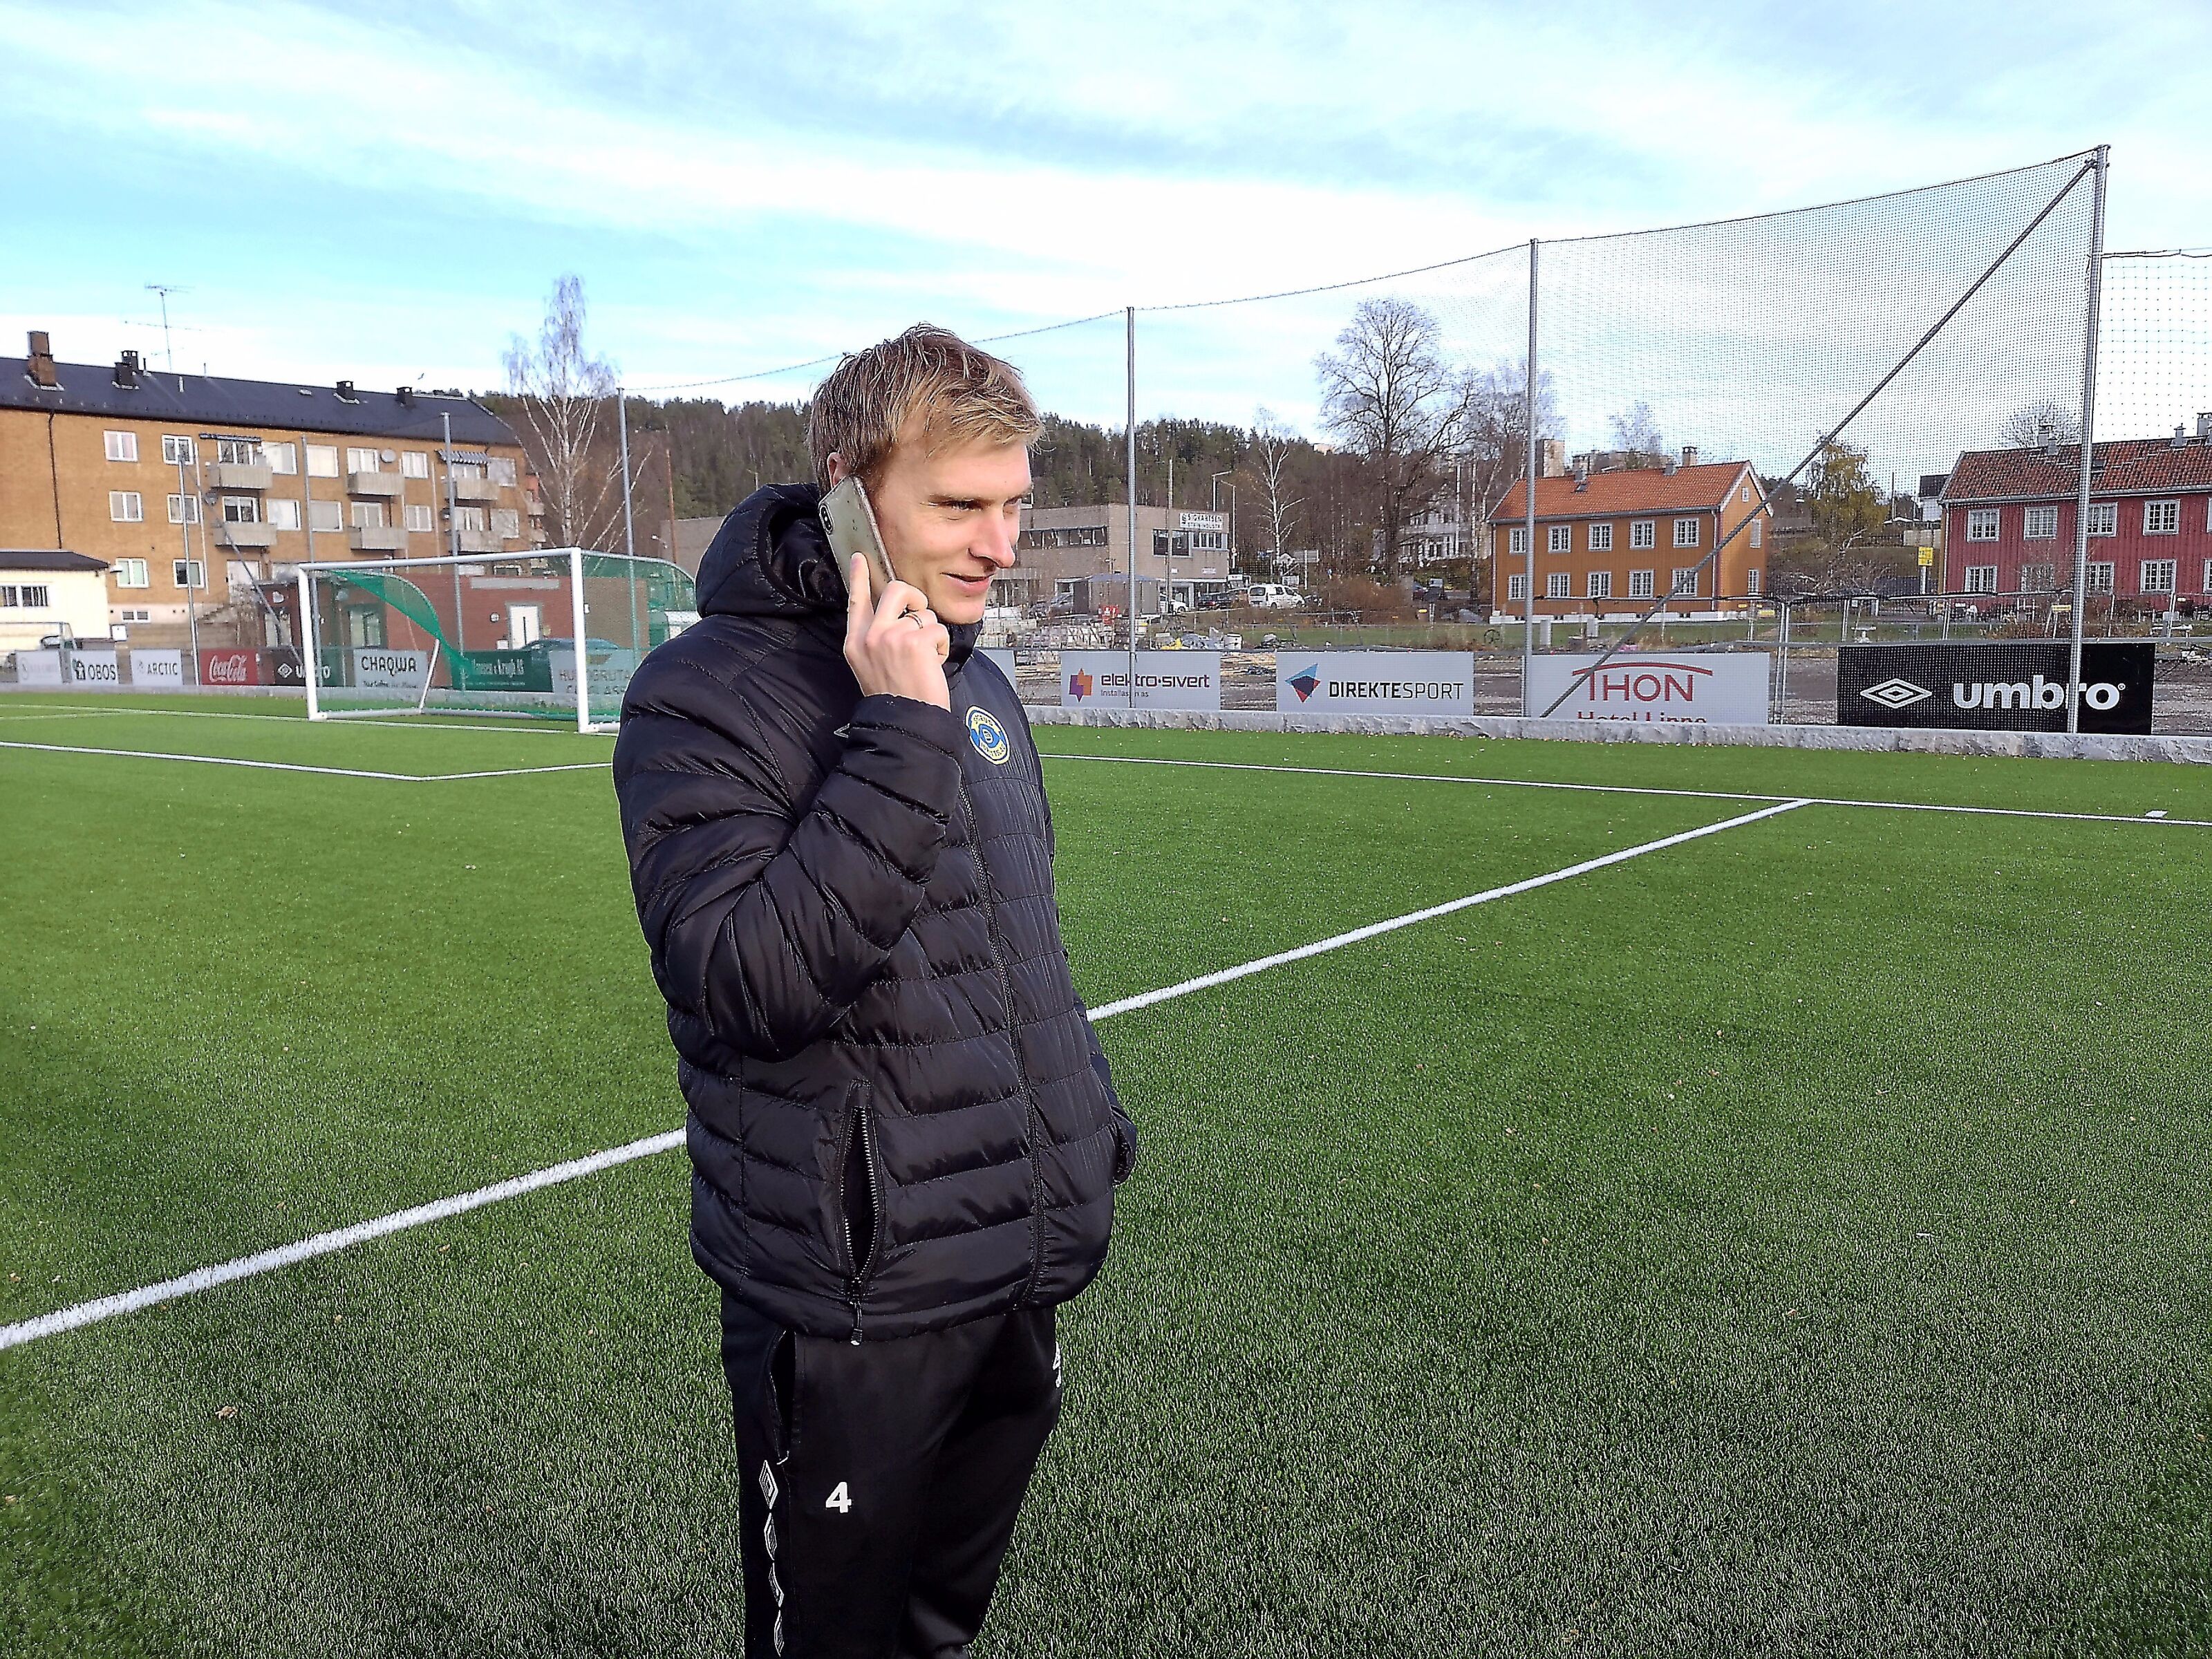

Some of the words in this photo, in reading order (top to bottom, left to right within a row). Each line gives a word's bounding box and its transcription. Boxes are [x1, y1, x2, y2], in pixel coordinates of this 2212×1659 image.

[88, 665, 116, 680] OBOS
[147, 663, 178, 675] ARCTIC
[362, 657, 416, 676] CHAQWA
[1329, 681, 1463, 700] DIREKTESPORT
[1573, 662, 1713, 702] THON
[825, 1481, 852, 1513] 4
